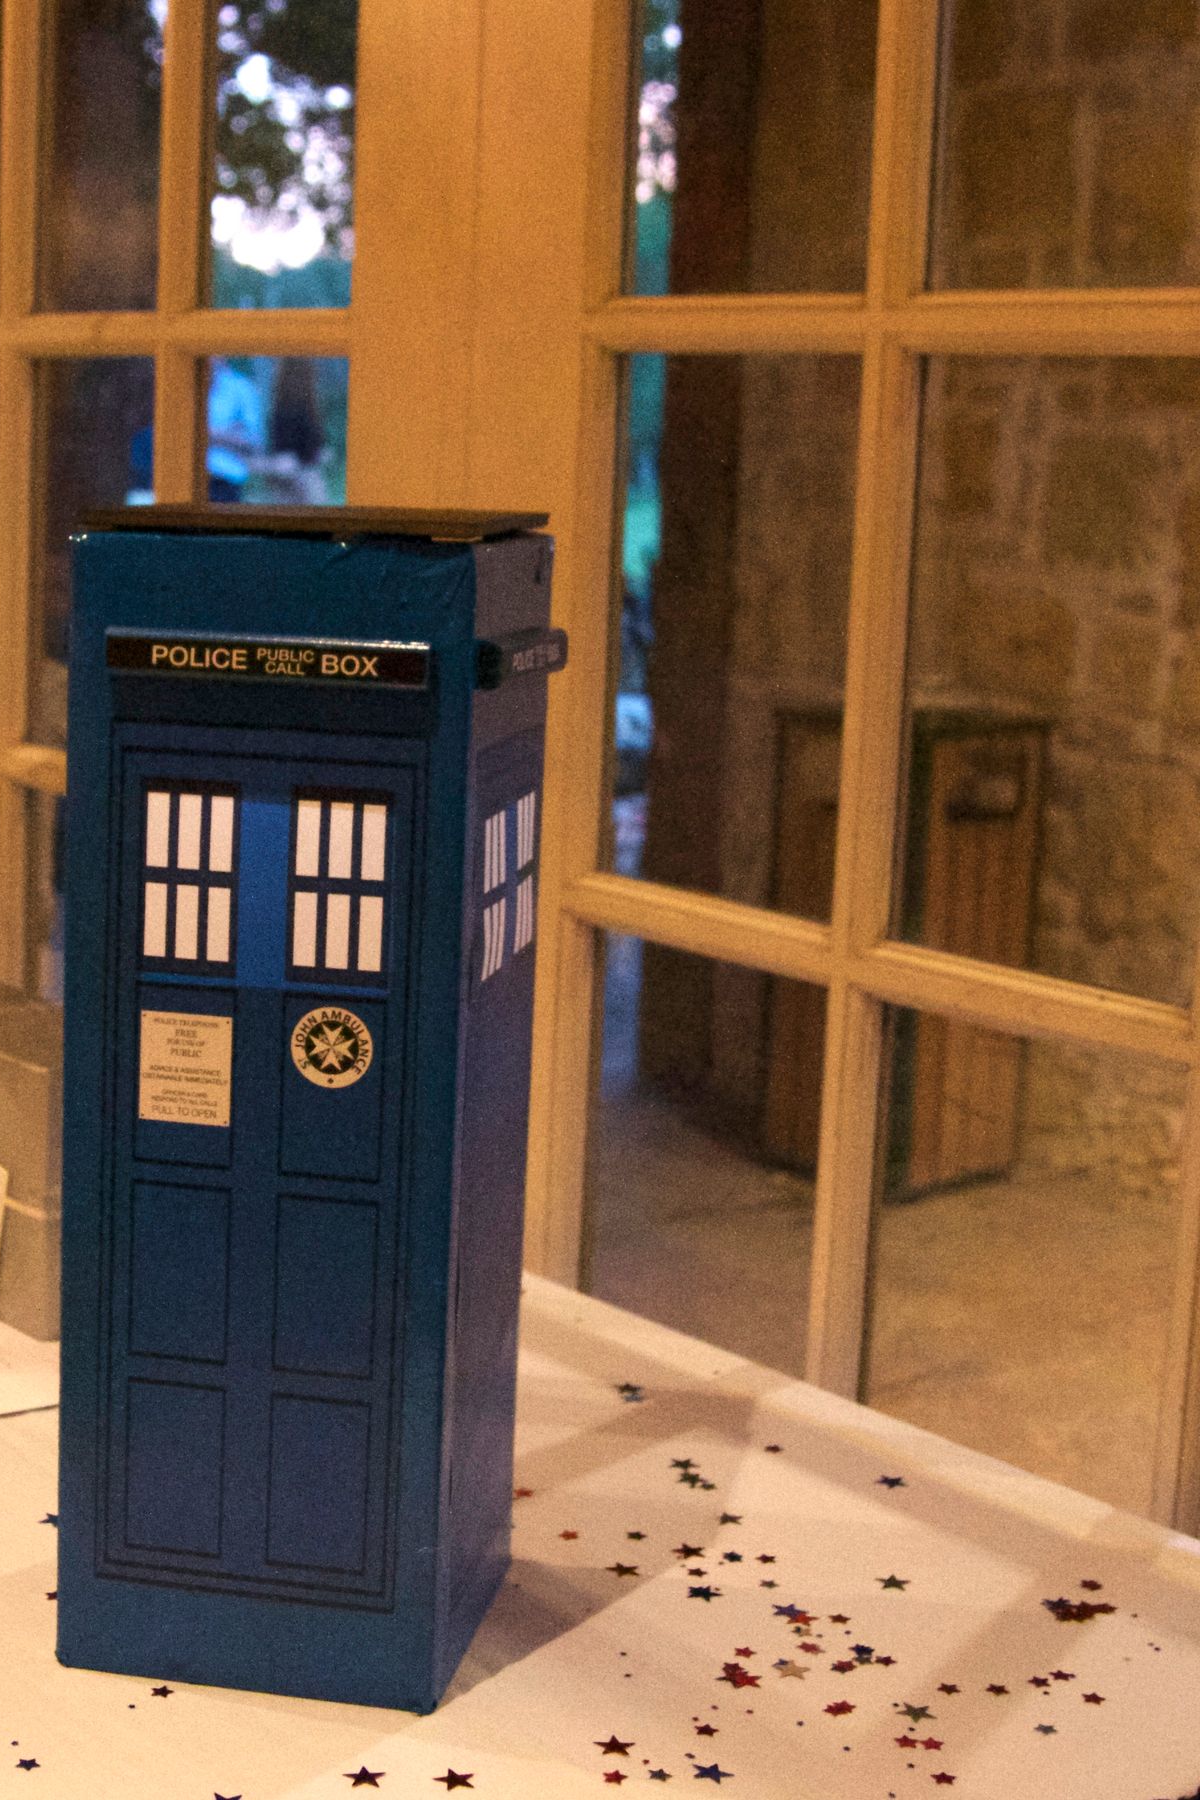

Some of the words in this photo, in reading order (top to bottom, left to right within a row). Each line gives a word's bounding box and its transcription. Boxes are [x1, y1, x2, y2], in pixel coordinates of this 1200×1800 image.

[151, 644, 247, 670] POLICE
[256, 648, 314, 663] PUBLIC
[265, 661, 305, 675] CALL
[321, 653, 378, 677] BOX
[175, 1029, 197, 1038] FREE
[295, 1015, 318, 1050] JOHN
[320, 1010, 370, 1075] AMBULANCE
[170, 1047, 202, 1058] PUBLIC
[151, 1104, 175, 1115] PULL
[178, 1106, 190, 1116] TO
[191, 1108, 217, 1118] OPEN
